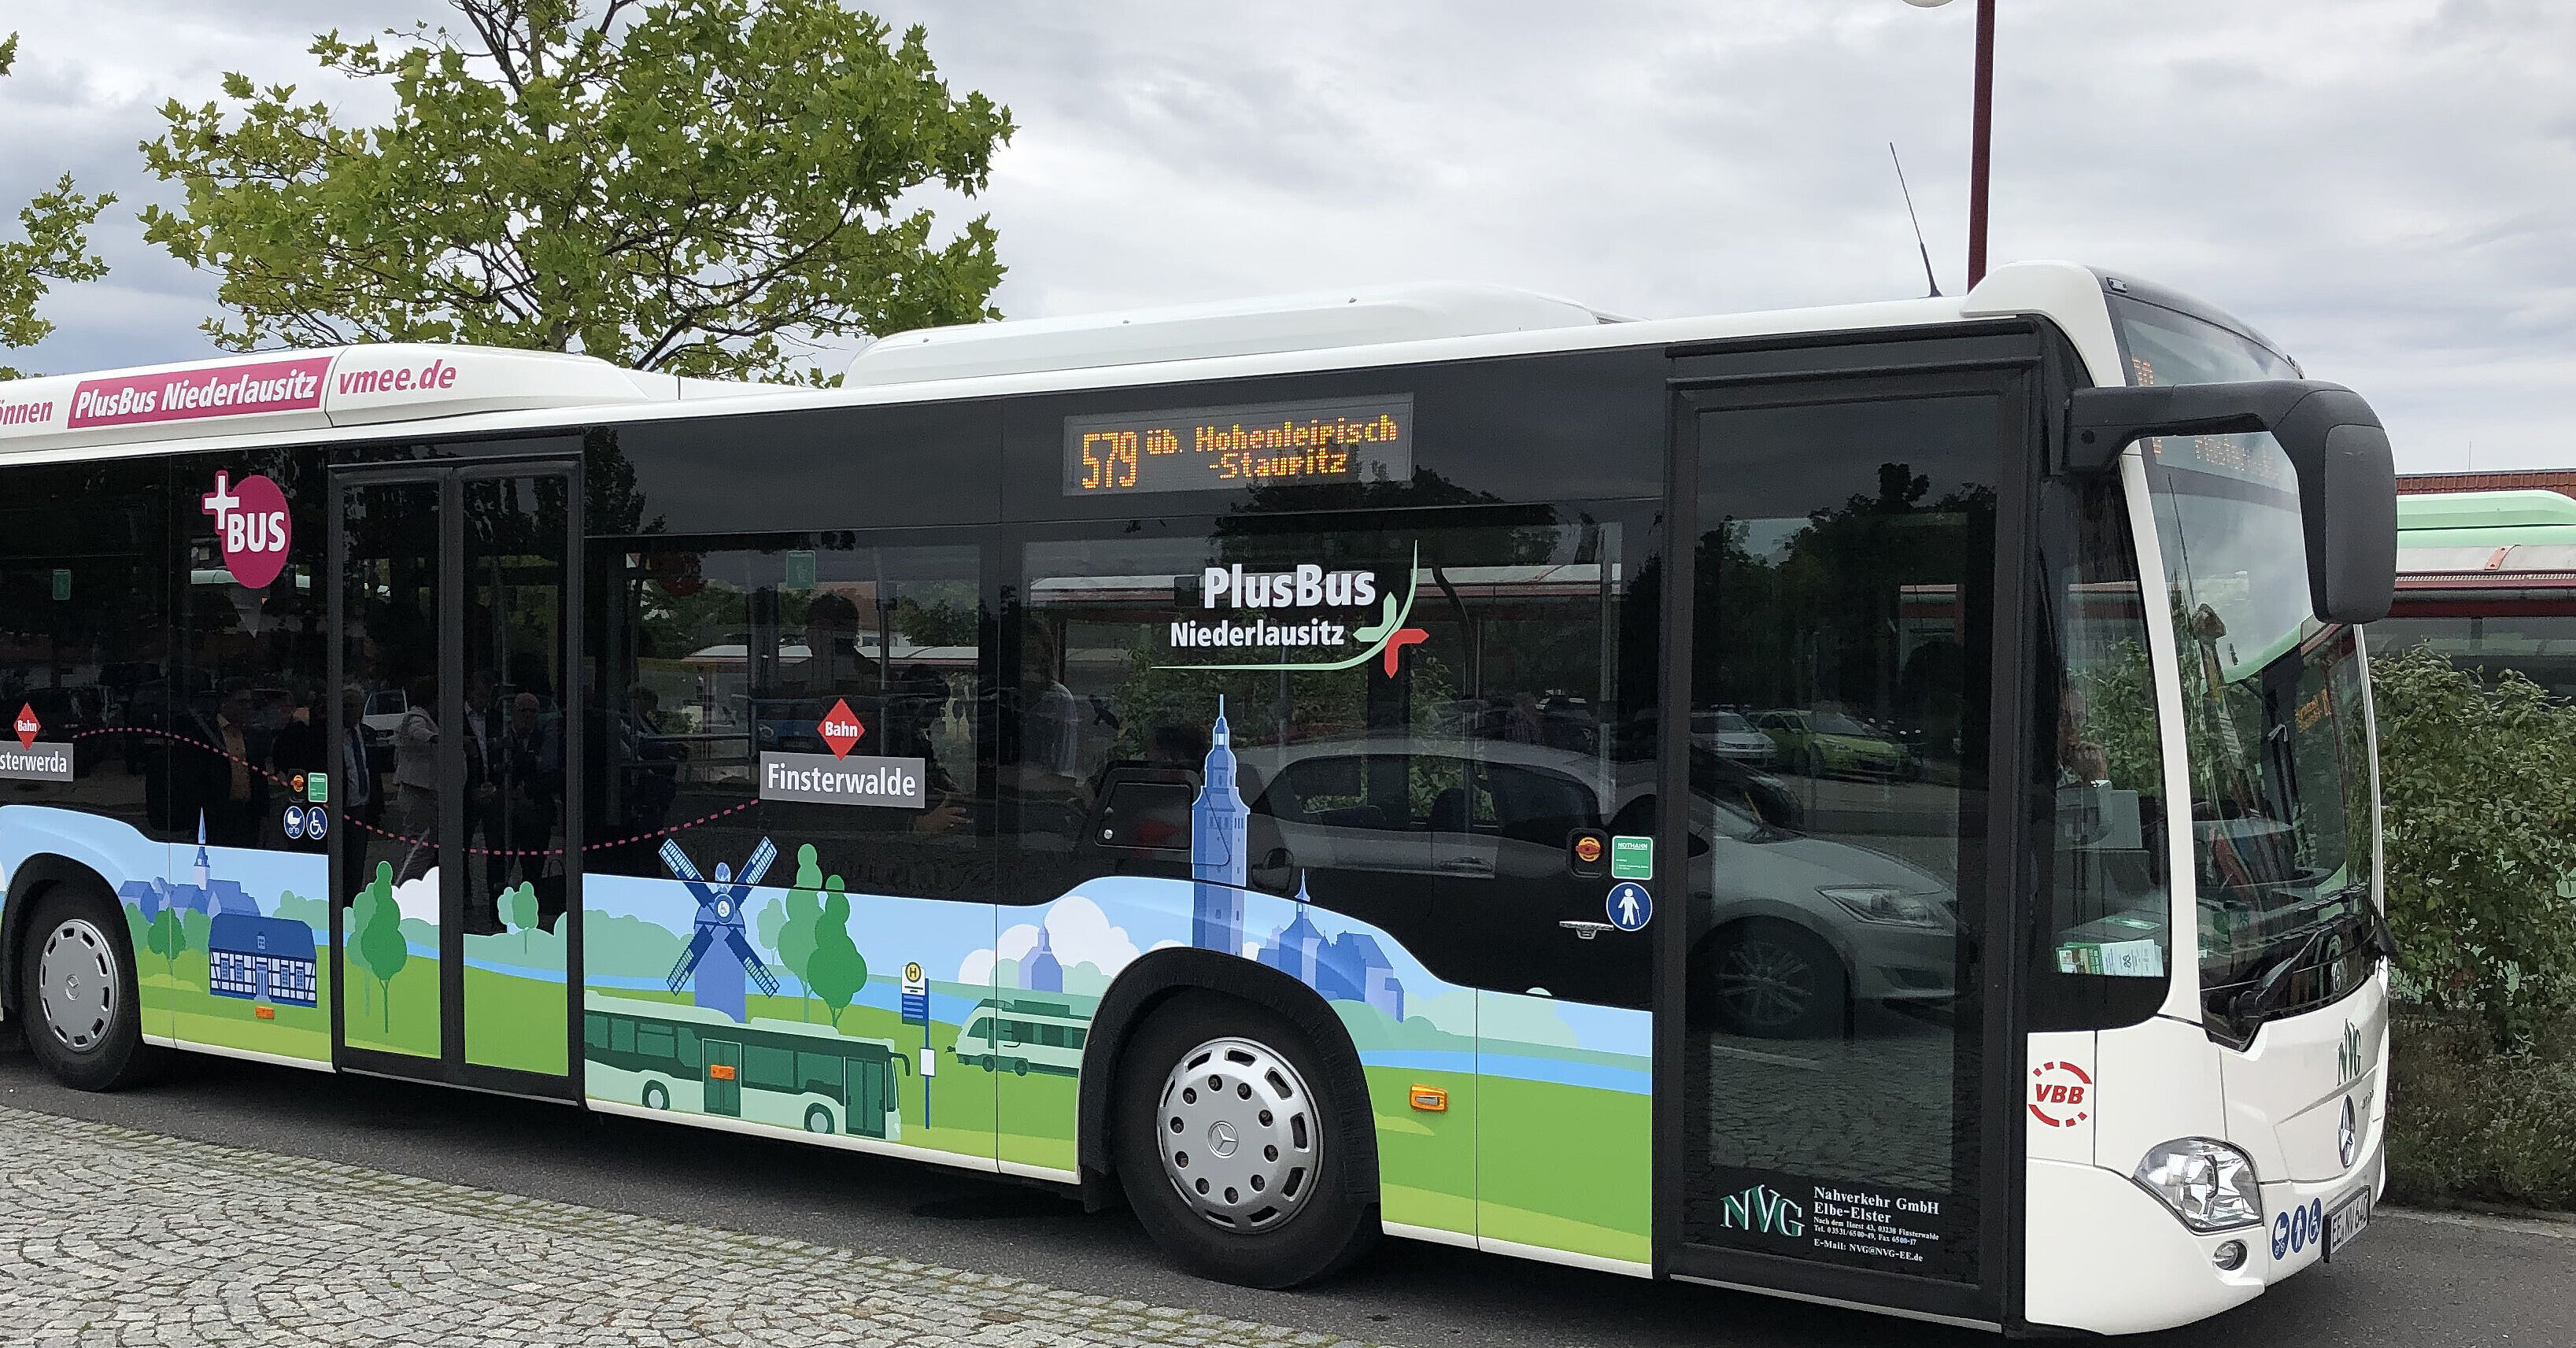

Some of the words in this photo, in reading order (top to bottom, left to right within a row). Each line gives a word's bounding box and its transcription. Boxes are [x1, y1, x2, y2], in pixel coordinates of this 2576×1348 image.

[339, 359, 456, 395] vmee.de
[76, 386, 157, 419] PlusBus
[161, 369, 318, 411] Niederlausitz
[1082, 431, 1137, 489] 579
[1147, 429, 1183, 455] üb.
[1204, 563, 1376, 608] PlusBus
[1170, 619, 1344, 647] Niederlausitz
[17, 720, 37, 732] Bahn
[825, 721, 858, 738] Bahn
[0, 751, 67, 773] sterwerda
[767, 762, 916, 797] Finsterwalde
[2337, 1018, 2361, 1087] NVG
[2035, 1084, 2085, 1105] VBB
[1720, 1184, 1805, 1237] NVG
[1813, 1186, 1891, 1208] Nahverkehr
[1896, 1198, 1939, 1215] GmbH
[1813, 1202, 1891, 1223] Elbe-Elster
[1813, 1216, 1830, 1225] Nach
[1831, 1218, 1844, 1227] dem
[1898, 1228, 1939, 1241] Finsterwalde
[1878, 1234, 1890, 1243] Fax
[1813, 1238, 1846, 1250] E-Mail:
[1850, 1243, 1924, 1262] NVG@NVG-EE.de
